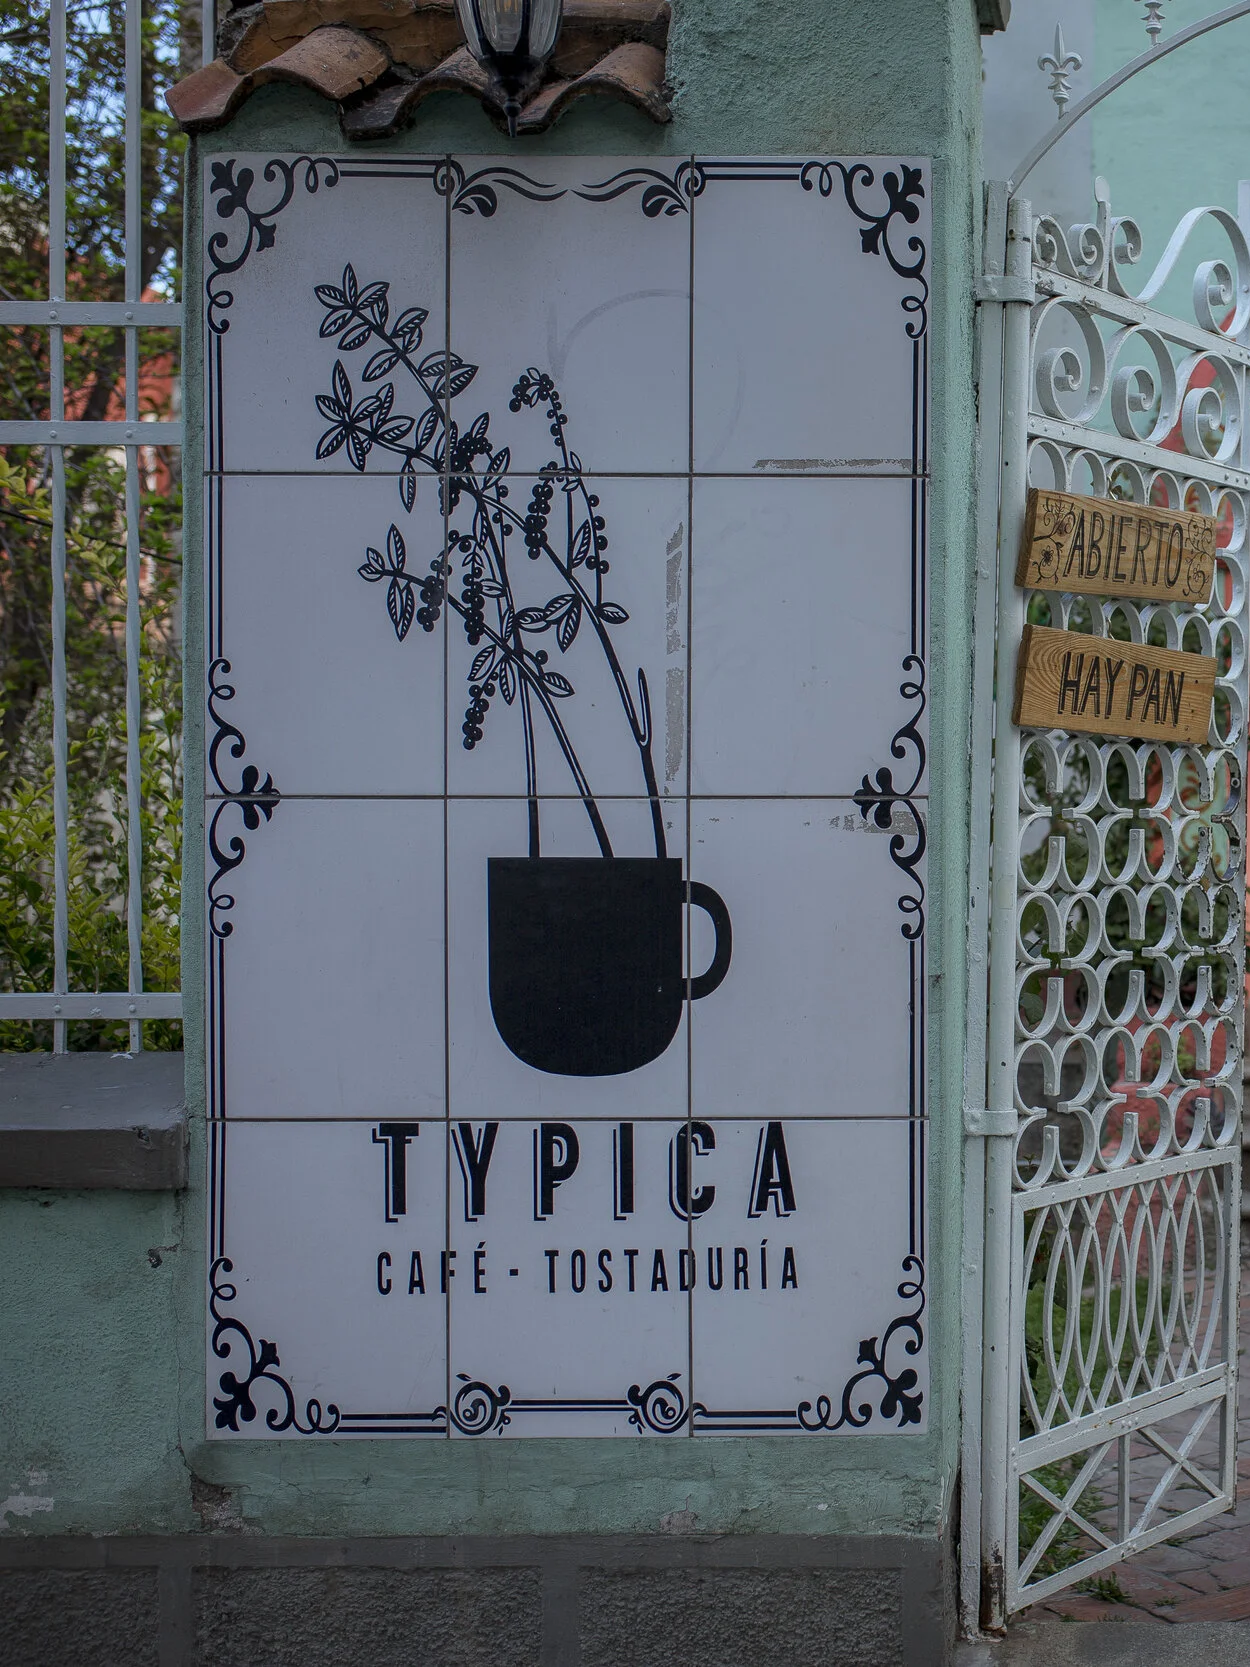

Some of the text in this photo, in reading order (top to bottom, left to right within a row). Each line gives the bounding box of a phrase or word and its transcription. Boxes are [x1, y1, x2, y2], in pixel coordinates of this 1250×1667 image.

[1062, 508, 1184, 589] ABIERTO
[1057, 650, 1185, 728] HAY PAN
[371, 1120, 797, 1224] TYPICA
[376, 1241, 488, 1296] CAFÉ
[544, 1238, 799, 1294] TOSTADURÍA
